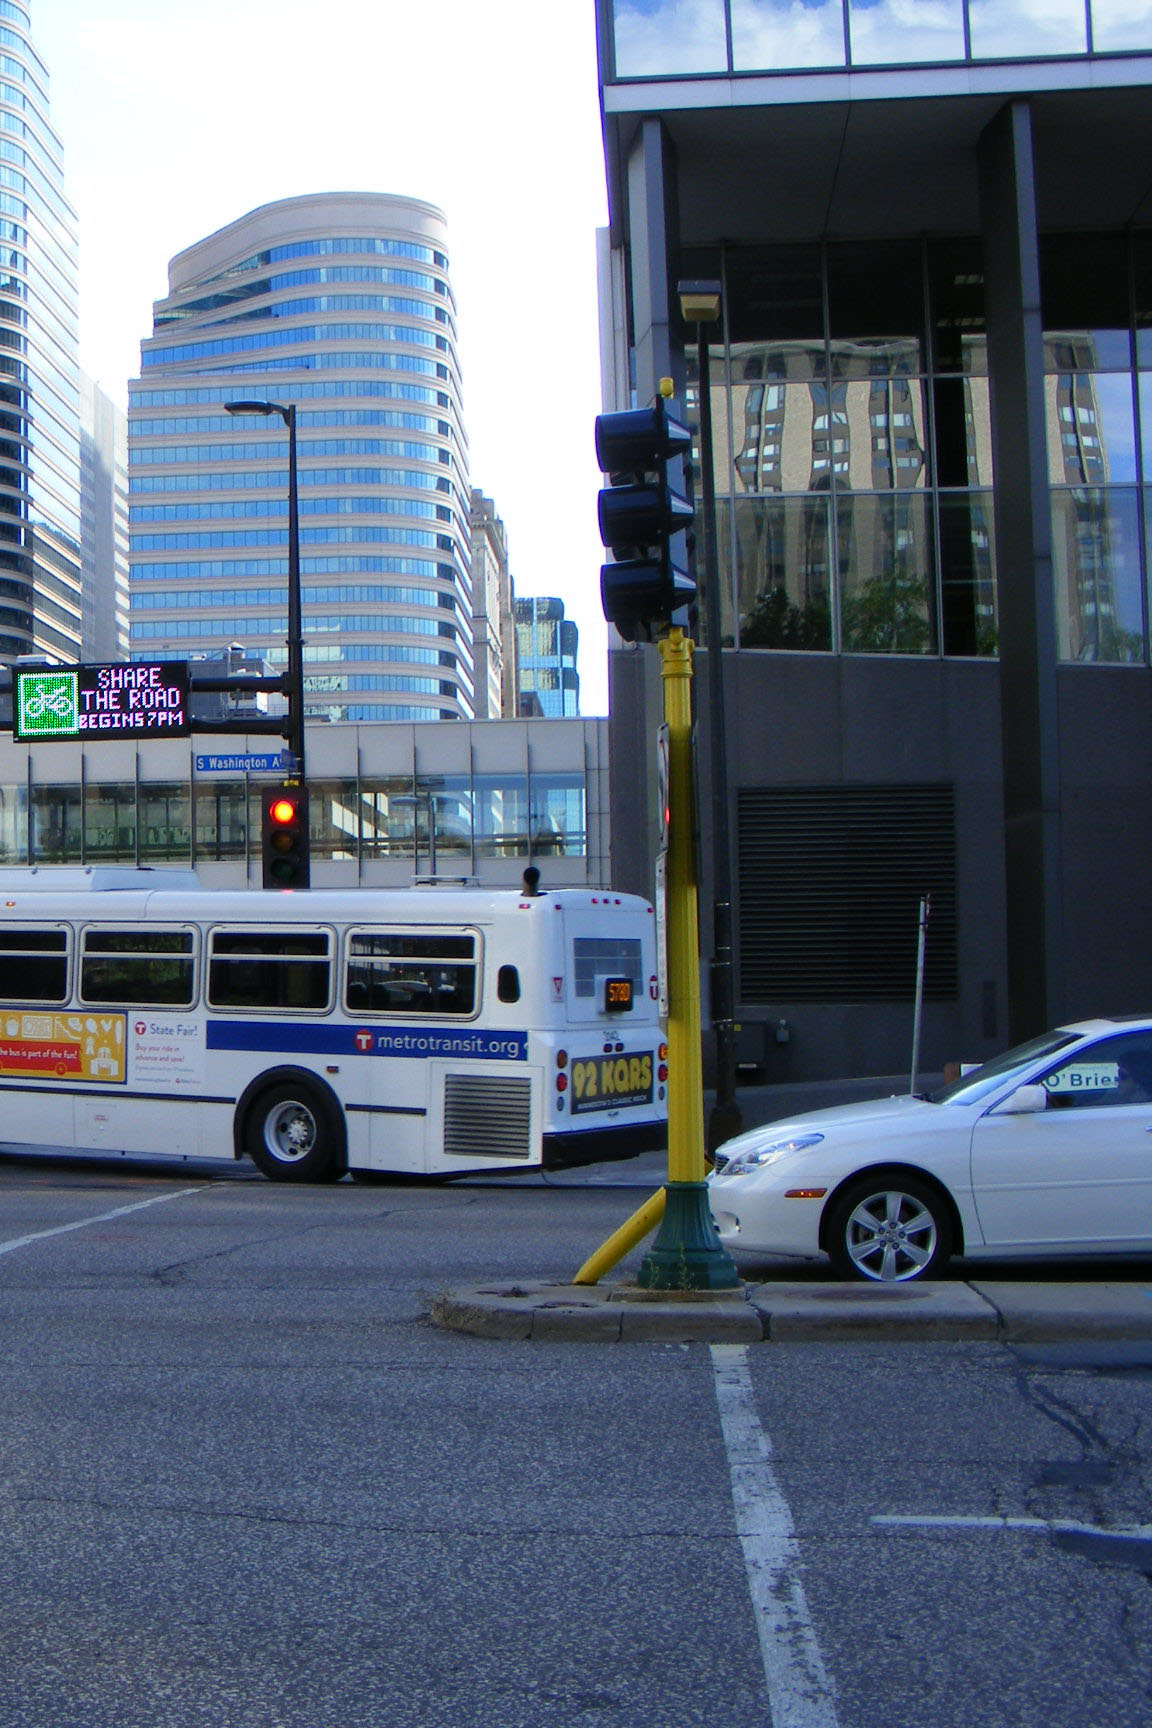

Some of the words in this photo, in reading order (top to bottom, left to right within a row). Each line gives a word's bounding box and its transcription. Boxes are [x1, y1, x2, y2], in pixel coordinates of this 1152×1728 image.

[98, 667, 161, 689] SHARE
[81, 689, 121, 710] THE
[129, 687, 180, 709] ROAD
[79, 711, 145, 729] BEGINS
[147, 710, 184, 727] 7PM
[197, 758, 204, 769] S
[209, 757, 267, 770] Washington
[150, 1023, 174, 1035] State
[9, 1048, 20, 1056] bus
[21, 1048, 26, 1056] is
[28, 1050, 41, 1059] part
[42, 1049, 50, 1058] of
[51, 1049, 62, 1058] the
[378, 1035, 519, 1058] metrotransit.org
[573, 1061, 598, 1098] 92
[601, 1055, 652, 1095] KQRS
